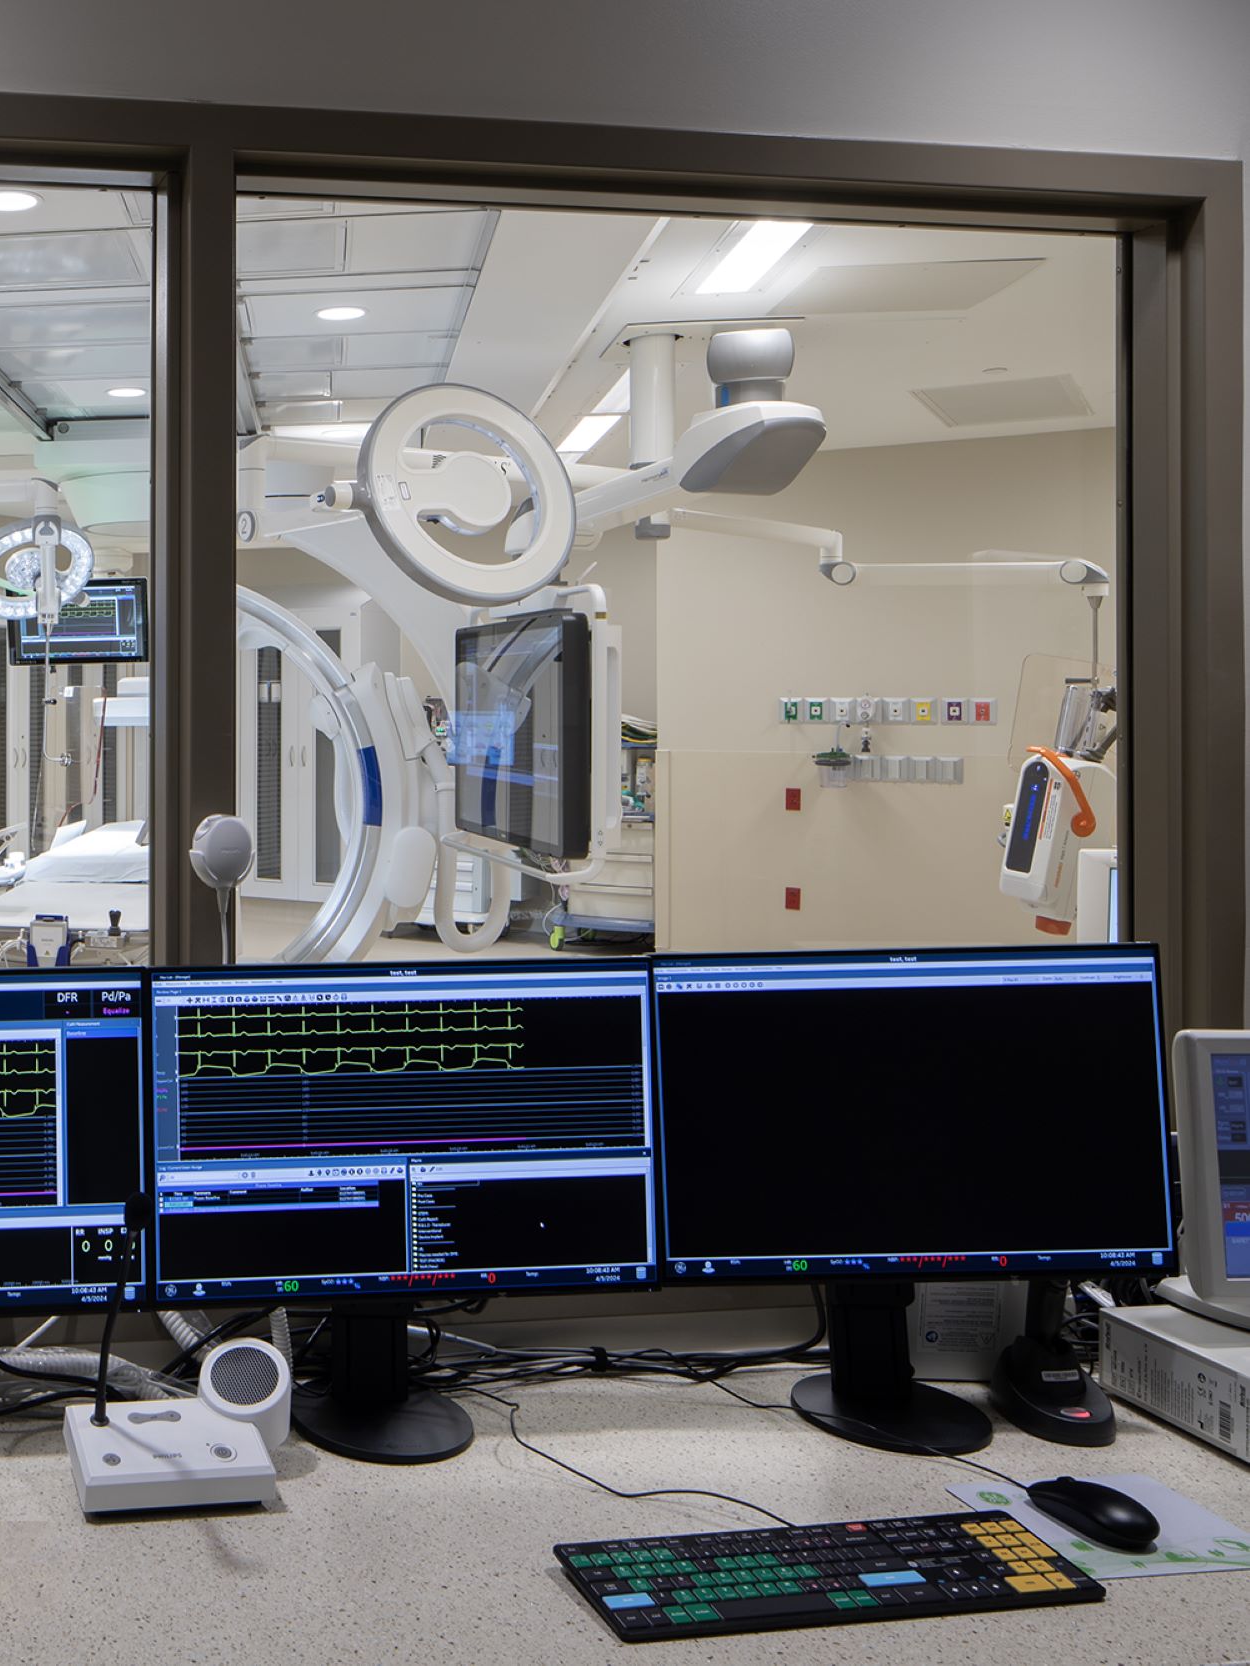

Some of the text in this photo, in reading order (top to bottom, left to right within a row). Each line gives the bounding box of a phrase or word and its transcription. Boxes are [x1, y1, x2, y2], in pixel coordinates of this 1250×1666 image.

[240, 518, 247, 534] 2
[57, 992, 78, 1003] DFR
[102, 991, 132, 1003] Pd/Pa
[103, 1006, 130, 1016] Equalize
[75, 1228, 85, 1236] RR
[82, 1239, 113, 1252] 0 0
[792, 1260, 808, 1272] 60
[999, 1256, 1008, 1267] 0
[488, 1272, 496, 1284] 0
[284, 1281, 300, 1292] 60
